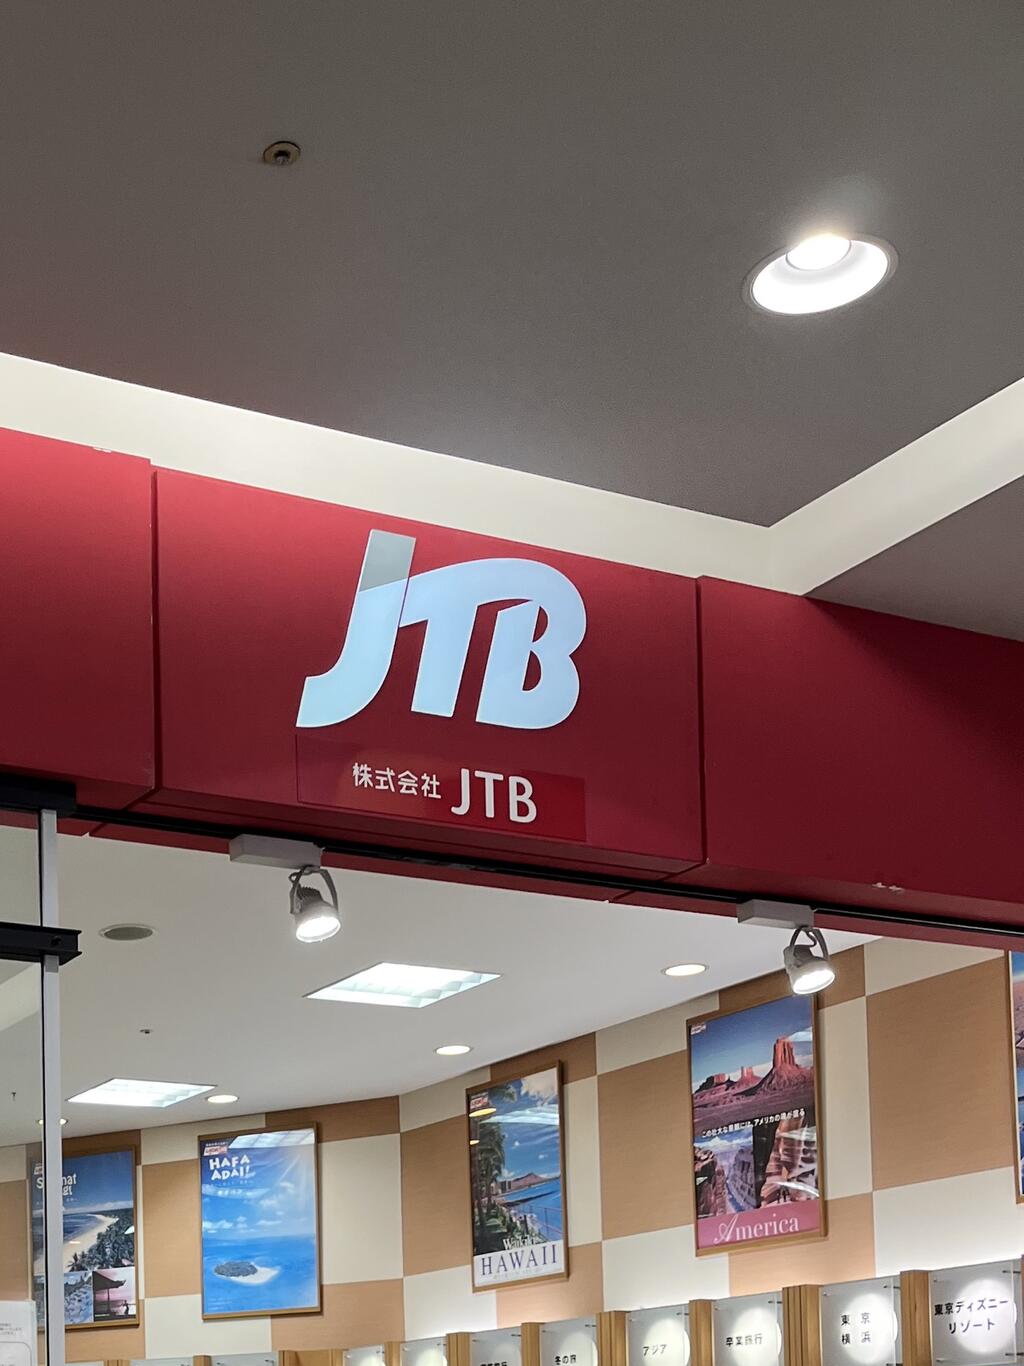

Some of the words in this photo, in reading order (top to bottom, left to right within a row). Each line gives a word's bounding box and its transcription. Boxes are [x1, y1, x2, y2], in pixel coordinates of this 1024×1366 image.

[296, 529, 587, 729] JTB
[351, 761, 442, 799] 株式会社
[450, 768, 538, 823] JTB
[208, 1154, 251, 1171] HAFA
[210, 1165, 251, 1181] ADAI!
[713, 1213, 800, 1245] America
[481, 1244, 557, 1276] HAWAII
[933, 1297, 1010, 1316] 東京ディズニー
[840, 1311, 871, 1326] 東京
[841, 1331, 871, 1345] 横浜
